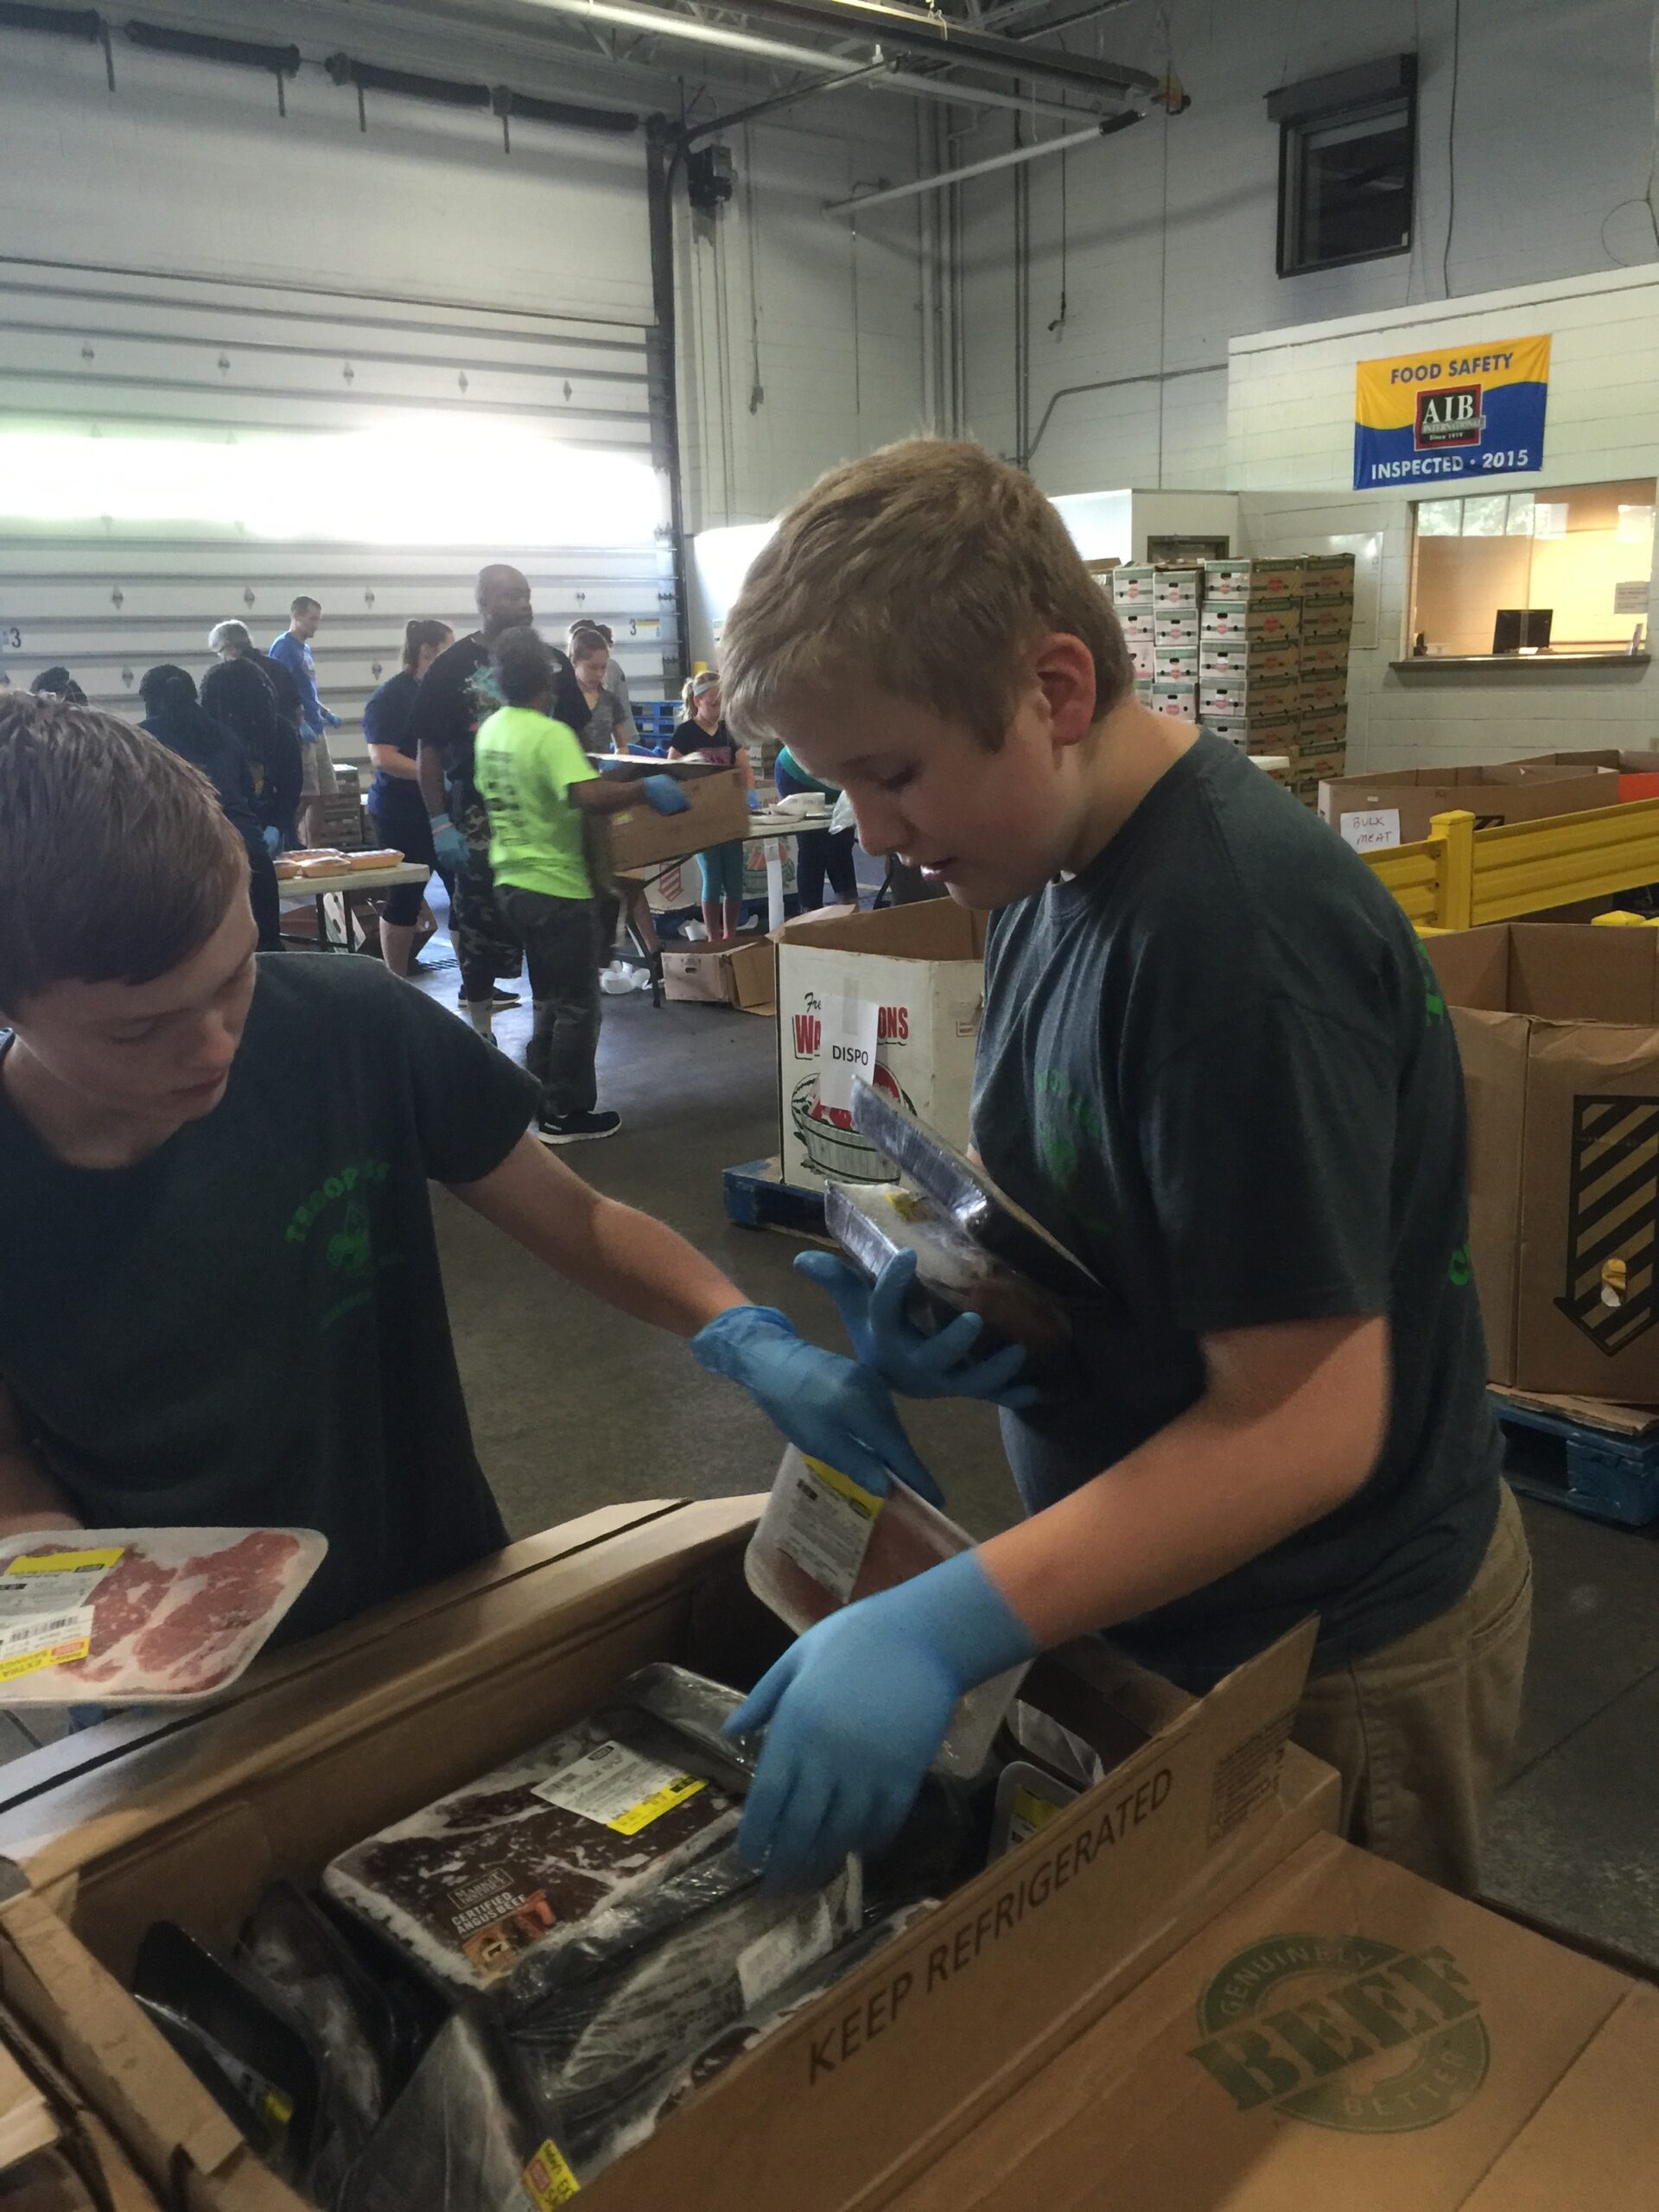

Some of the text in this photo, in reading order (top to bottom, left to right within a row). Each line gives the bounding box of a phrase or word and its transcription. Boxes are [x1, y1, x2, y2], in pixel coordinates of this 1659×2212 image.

[1390, 353, 1514, 385] FOOD SAFETY
[1423, 394, 1474, 424] AIB
[1371, 449, 1529, 480] INSPECTED 2015
[10, 627, 22, 648] 3
[629, 619, 637, 636] 3
[1353, 817, 1384, 828] BULK
[1357, 831, 1393, 845] MEAT
[804, 992, 821, 1013] Fre
[832, 1045, 869, 1065] DISPO
[451, 1891, 512, 1926] CERTIFIED
[456, 1893, 527, 1935] ANGUS BEEF
[809, 1971, 913, 2086] KEEP
[926, 1768, 1173, 1993] REFRIGERATED
[1219, 1944, 1375, 2018] GENUINELY
[1185, 1945, 1481, 2111] BEEF
[1344, 2049, 1465, 2117] BETTER
